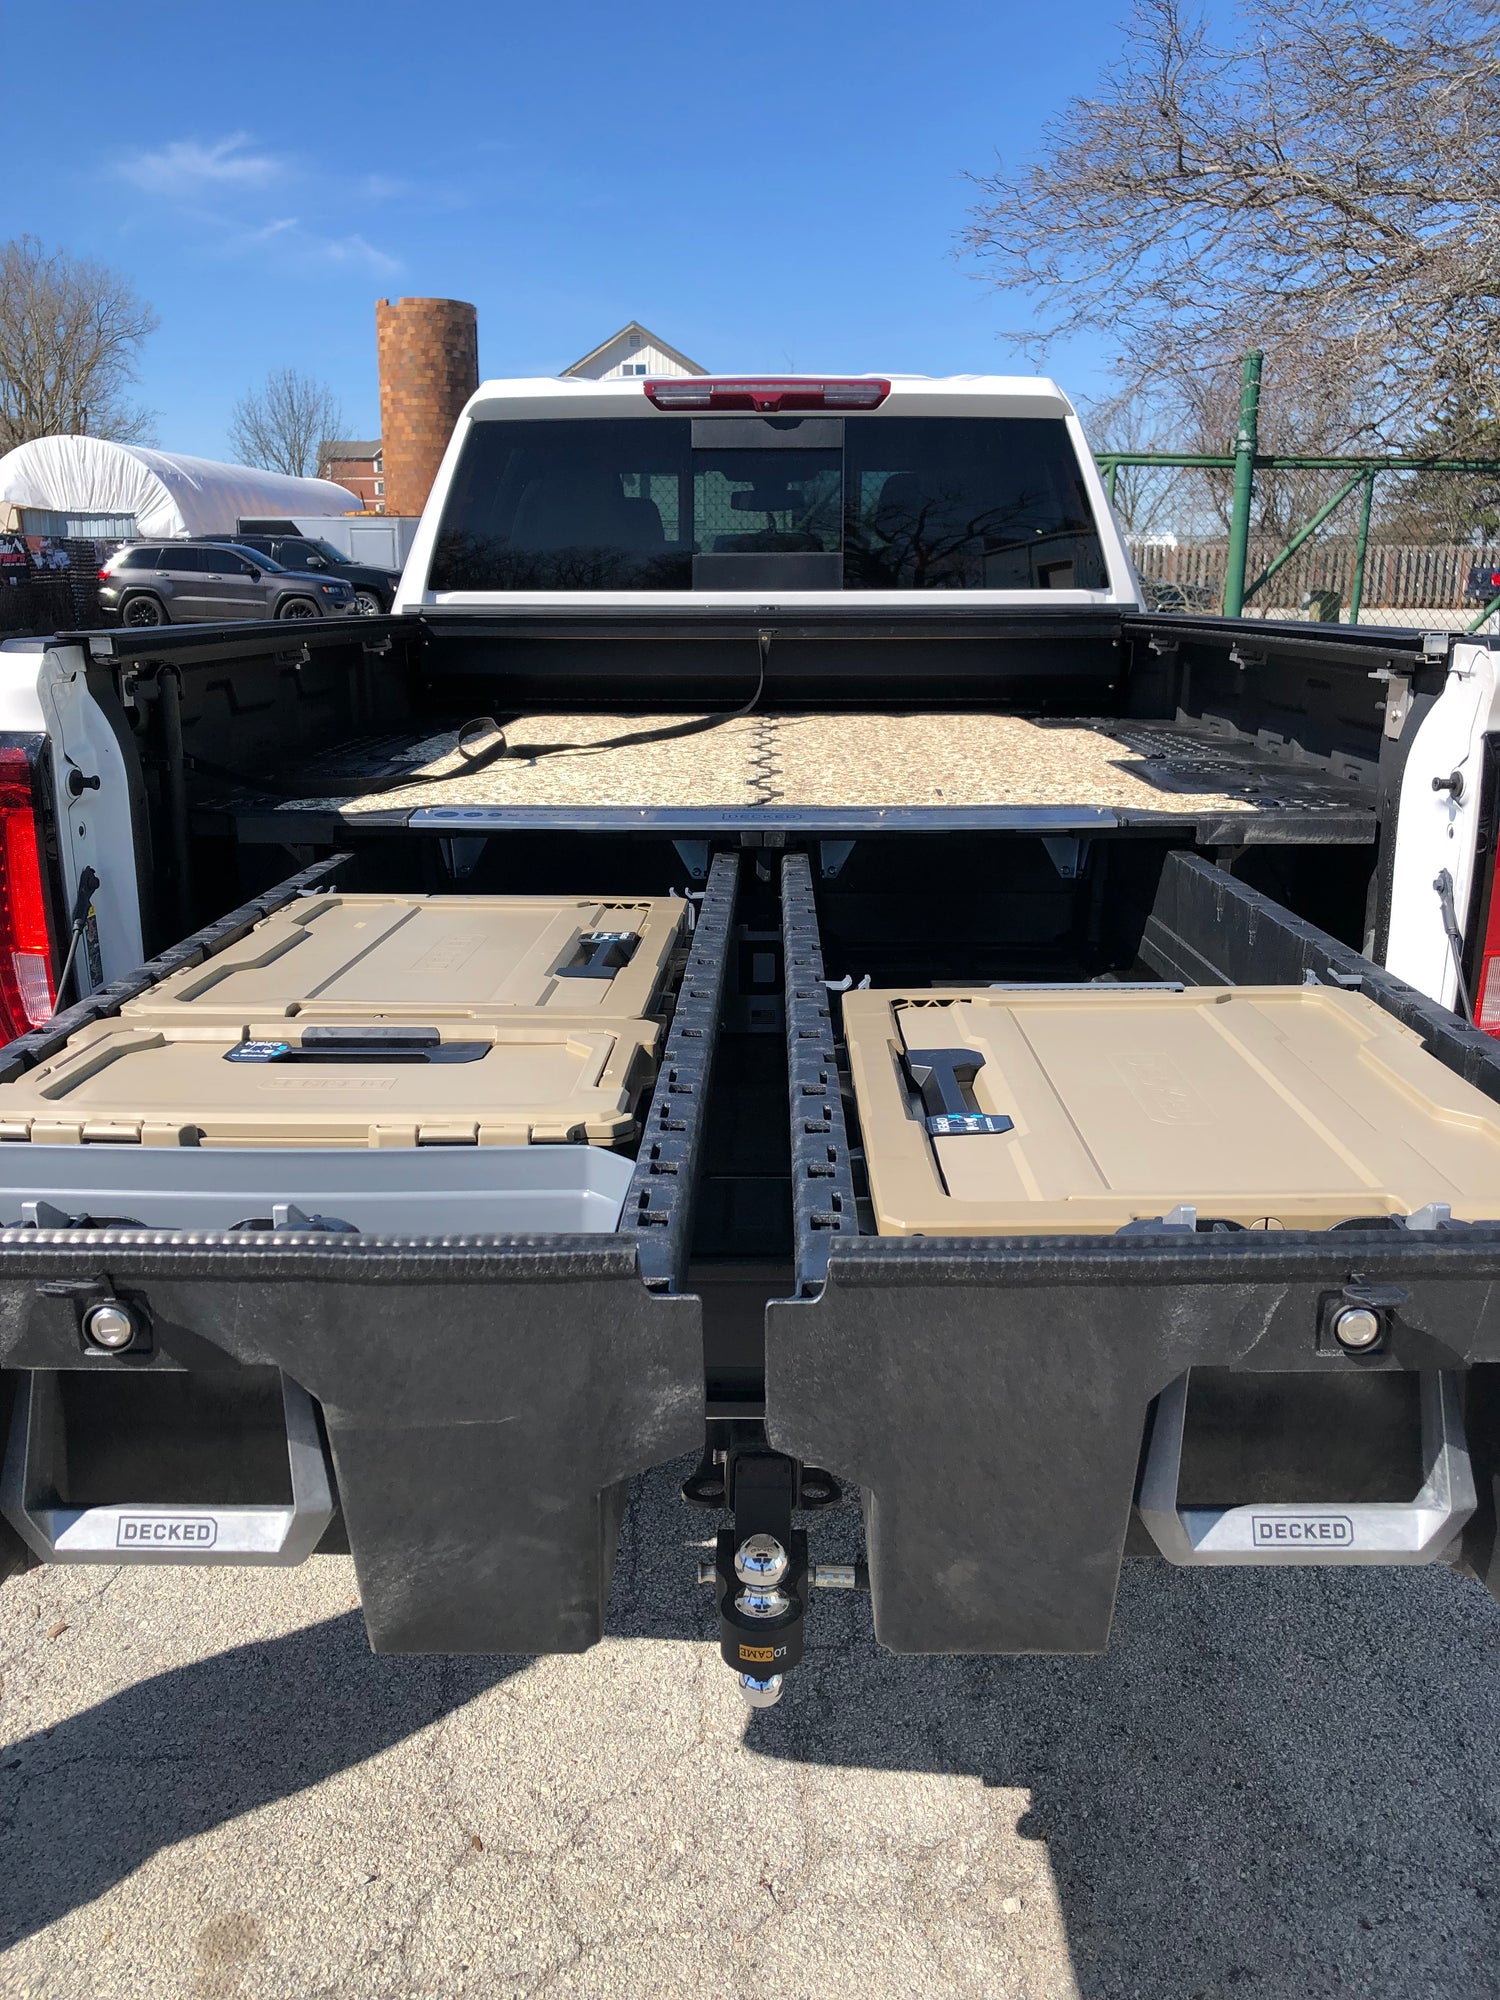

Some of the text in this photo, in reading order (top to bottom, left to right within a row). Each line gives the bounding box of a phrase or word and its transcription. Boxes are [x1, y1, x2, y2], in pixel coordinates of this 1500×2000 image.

[124, 1523, 210, 1541] DECKED
[1260, 1523, 1346, 1539] DECKED
[740, 1646, 787, 1659] LOCAME
